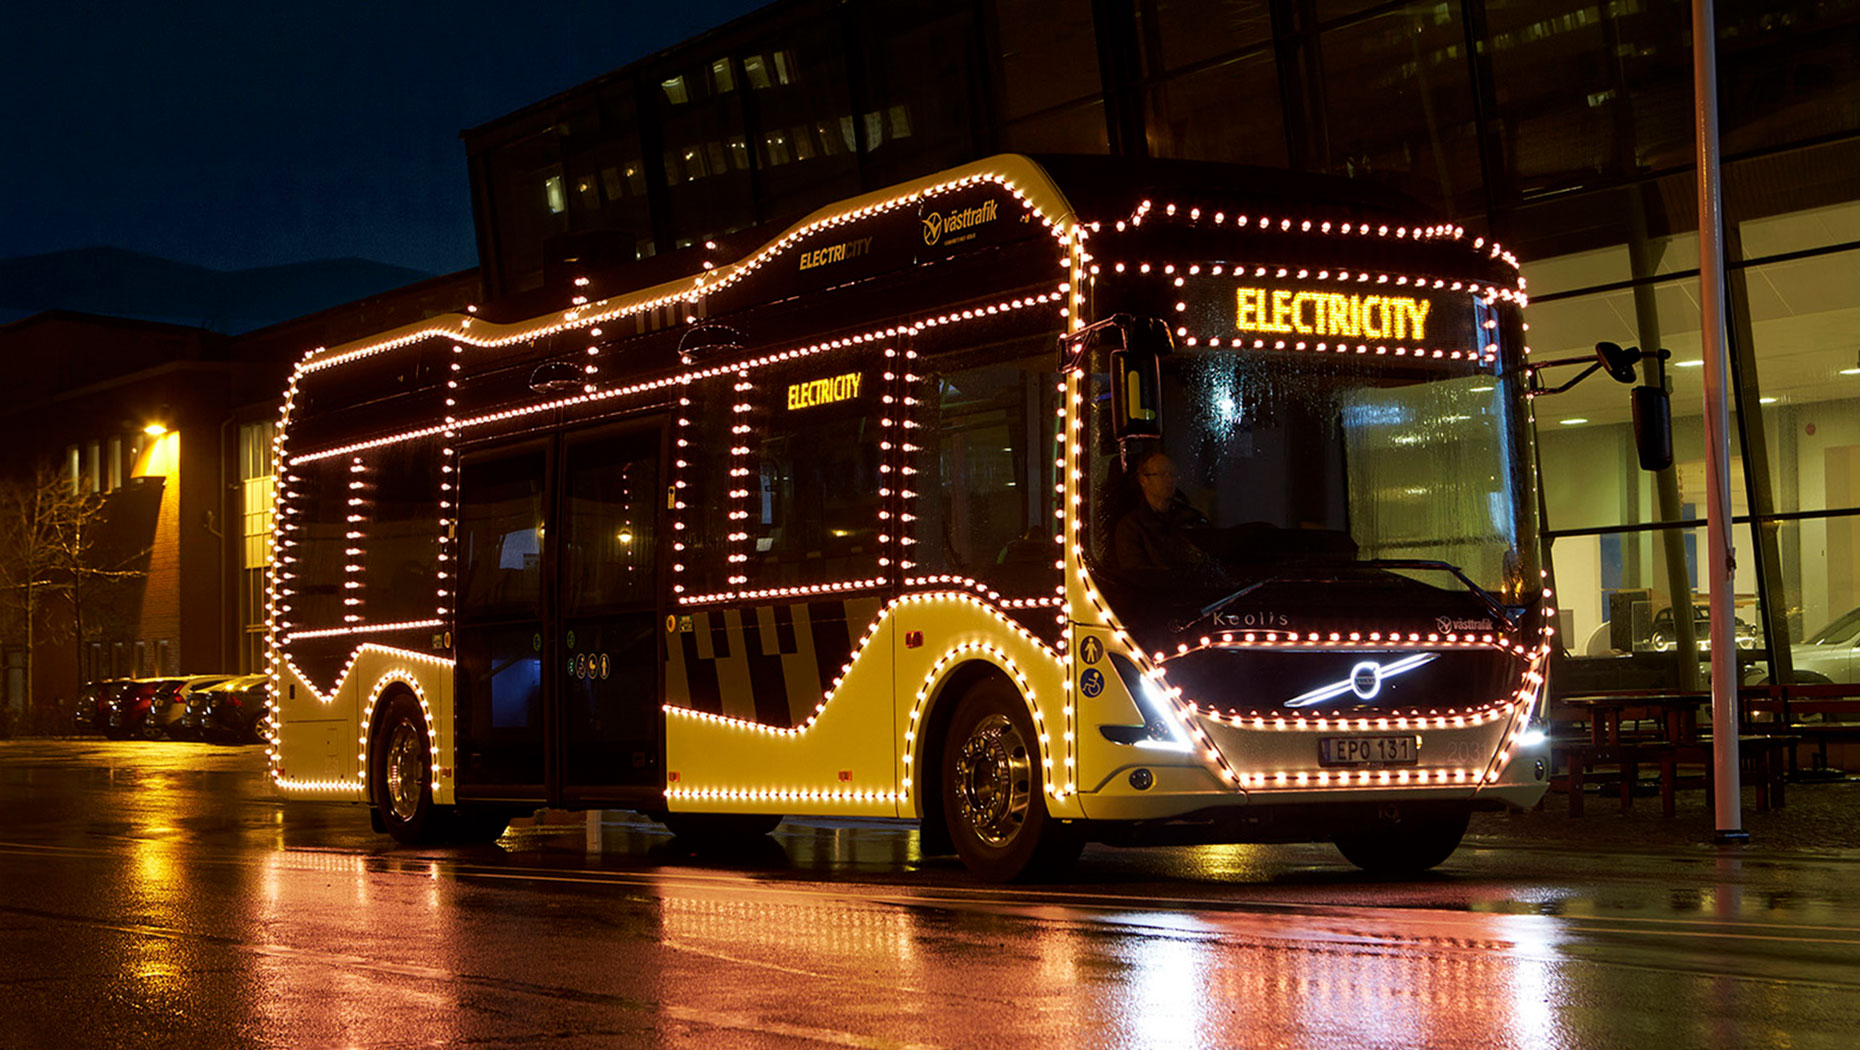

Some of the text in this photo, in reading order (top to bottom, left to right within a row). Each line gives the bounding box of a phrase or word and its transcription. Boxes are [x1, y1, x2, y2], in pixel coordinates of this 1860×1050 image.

[943, 199, 998, 233] västtrafik
[799, 236, 873, 271] ELECTRICITY
[1236, 287, 1432, 341] ELECTRICITY
[787, 372, 862, 410] ELECTRICITY
[1212, 611, 1289, 626] Keolis
[1452, 617, 1494, 631] västtrafik
[1336, 739, 1409, 760] EPO 131
